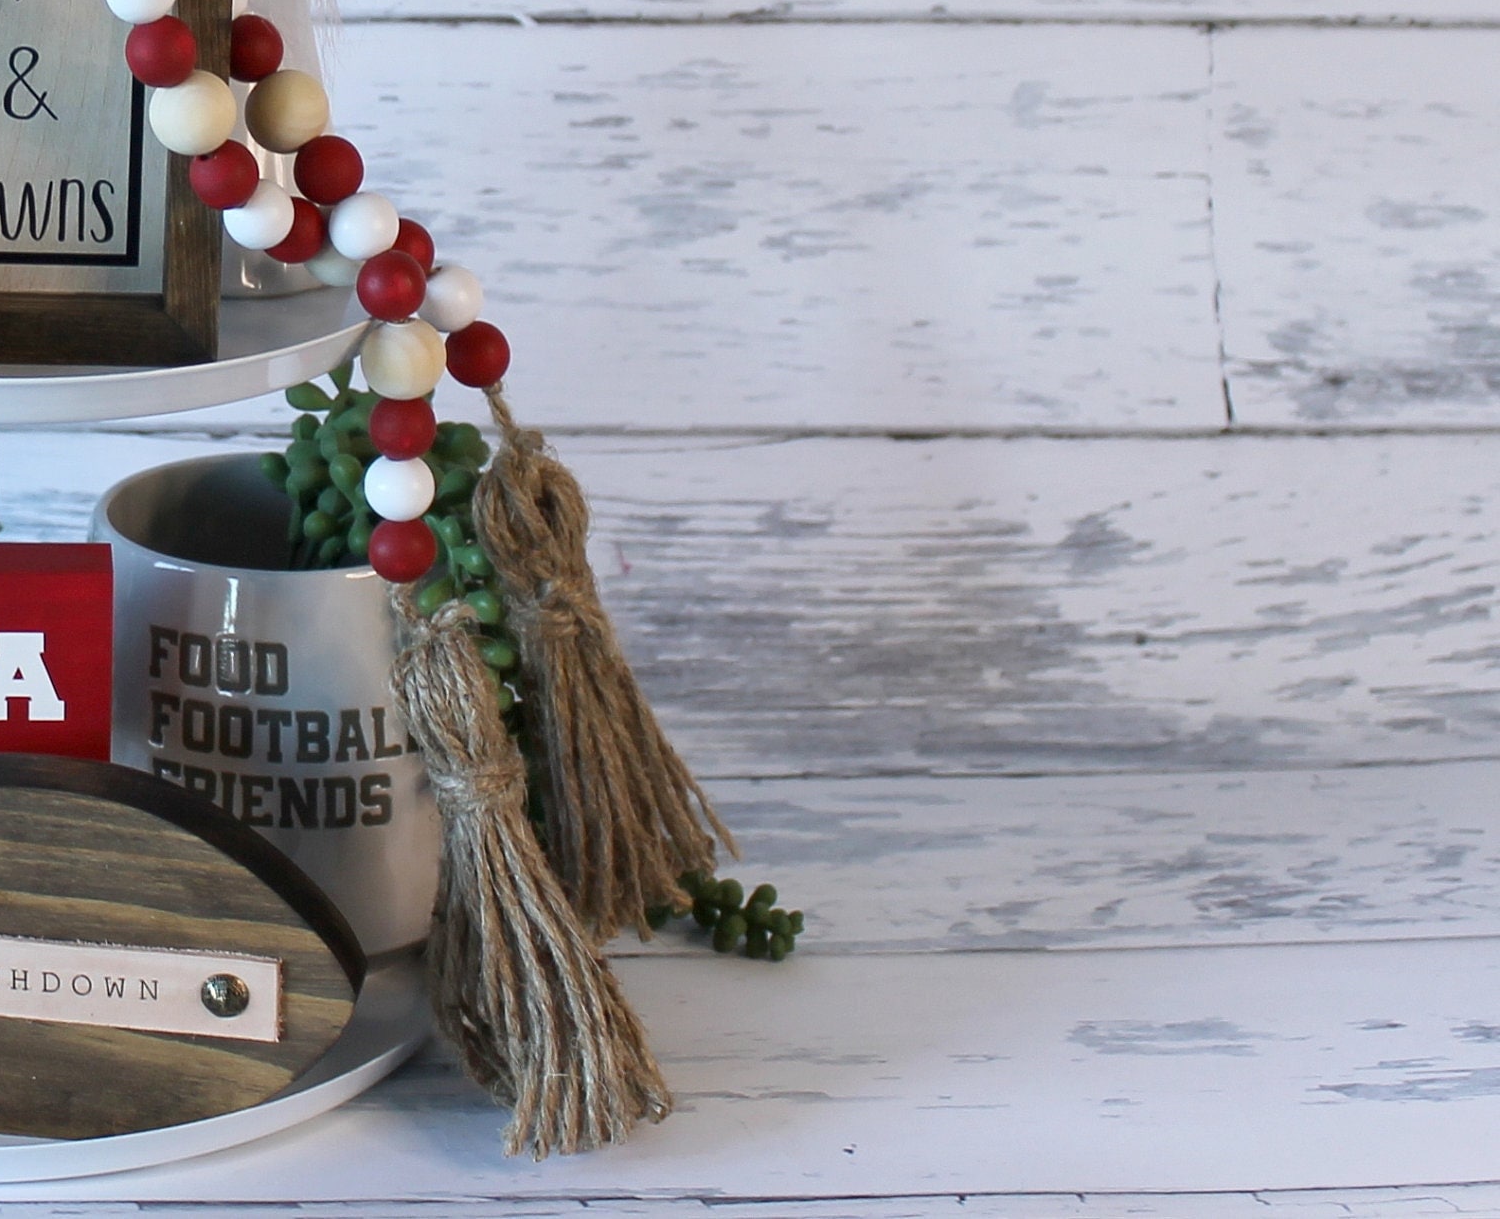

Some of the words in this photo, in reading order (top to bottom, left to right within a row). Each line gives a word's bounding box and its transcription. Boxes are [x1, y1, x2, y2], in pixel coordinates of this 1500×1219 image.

[3, 46, 58, 121] &
[150, 625, 290, 697] FOOD
[150, 691, 421, 764] FOOTBAL
